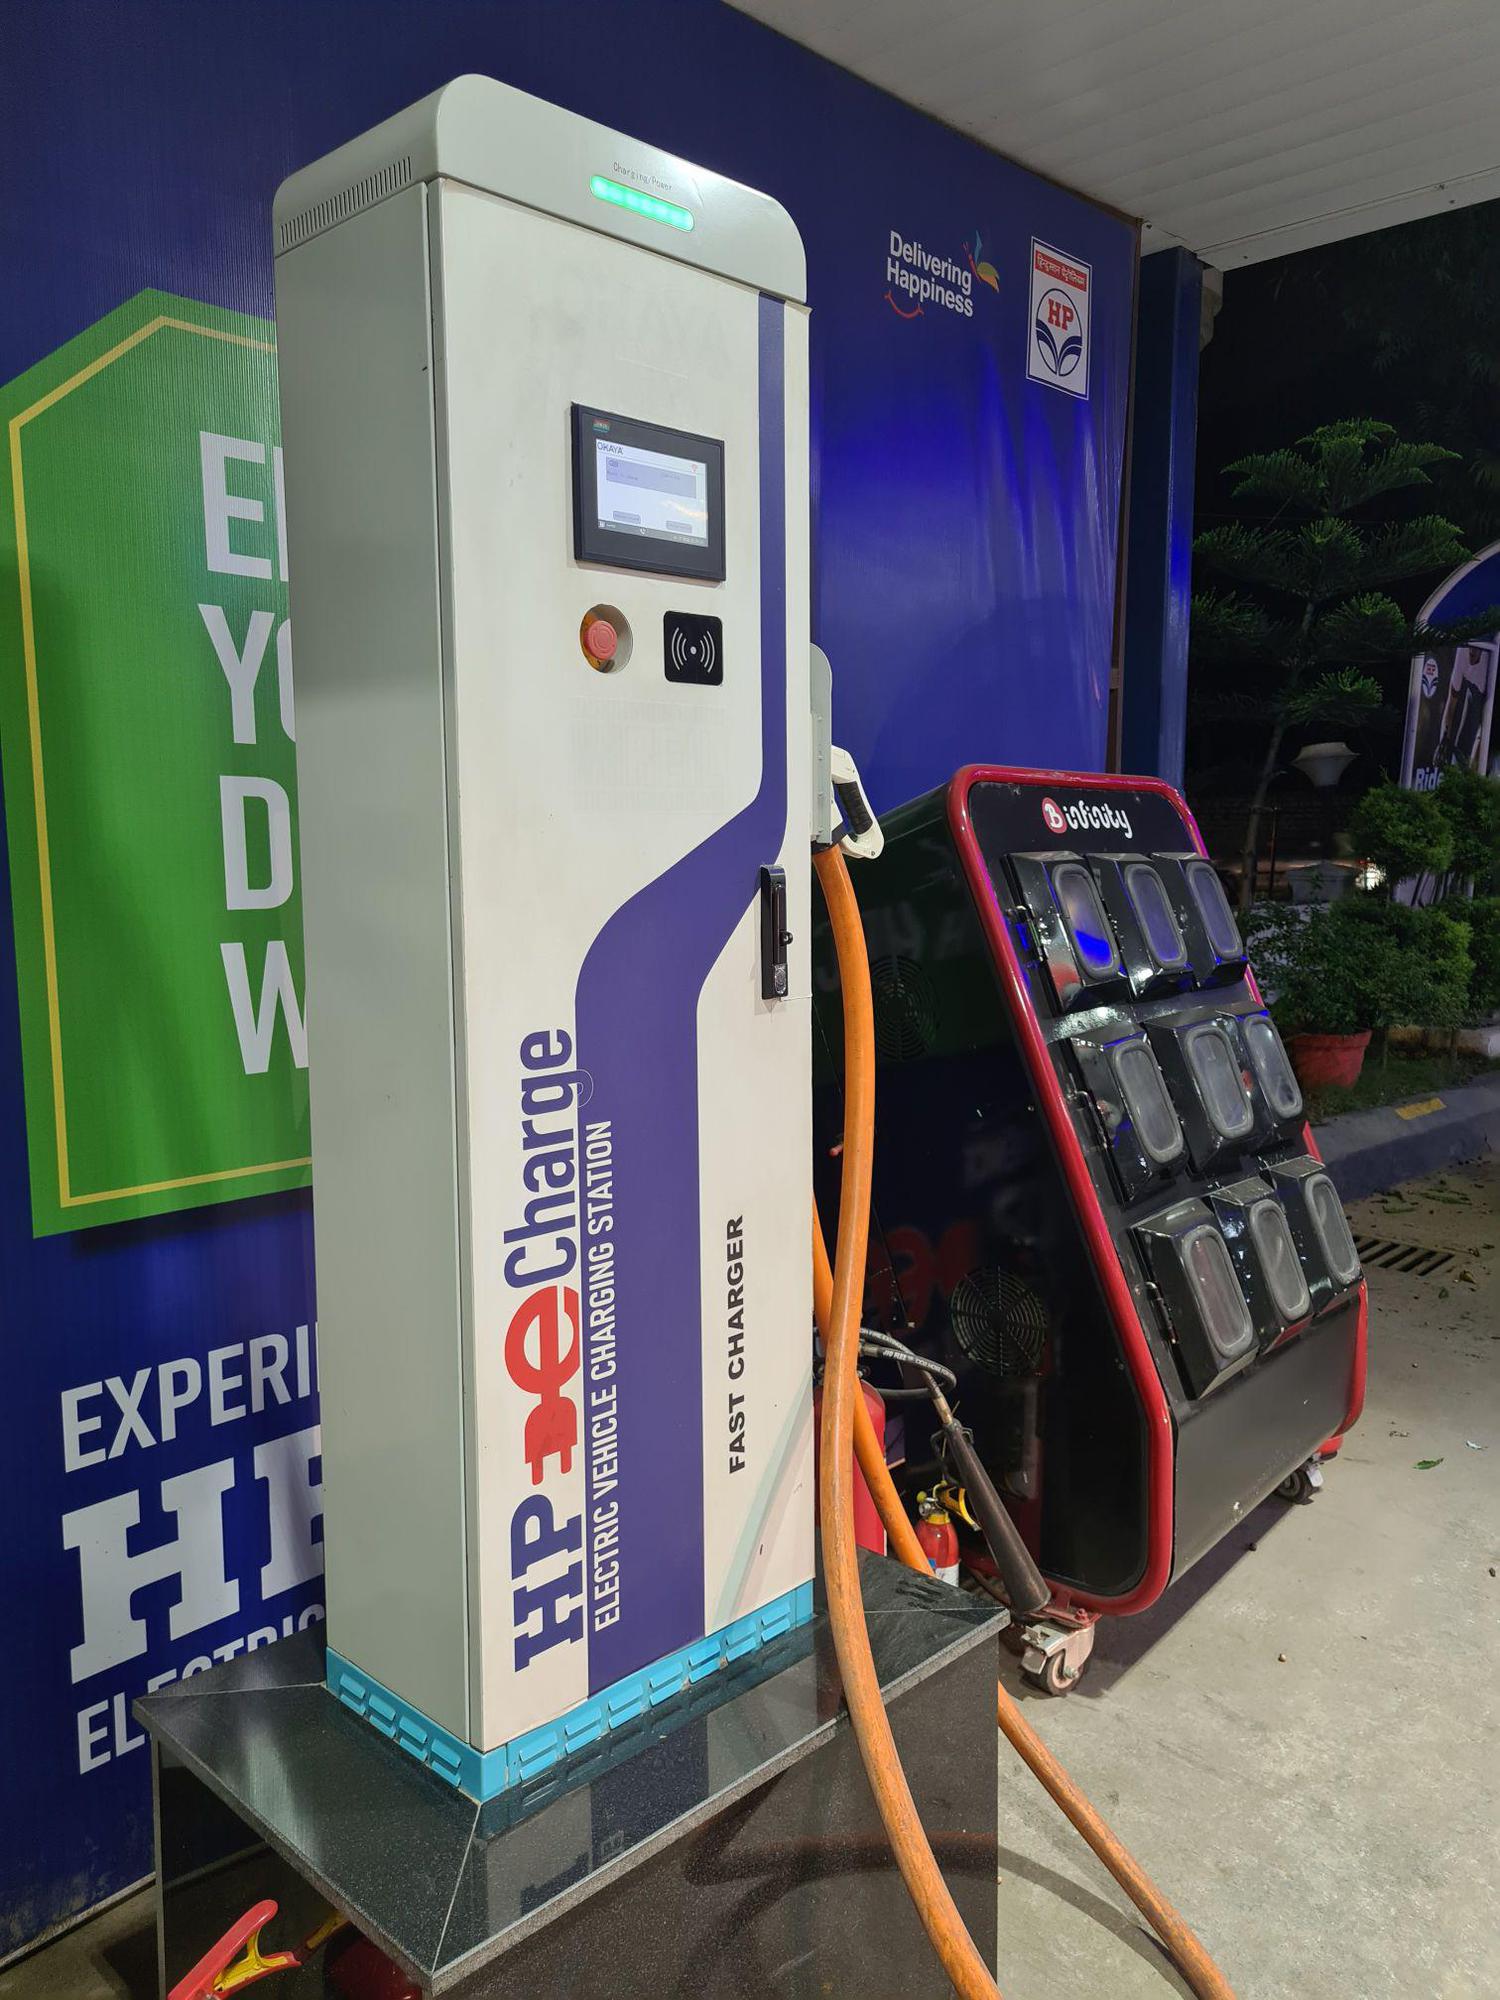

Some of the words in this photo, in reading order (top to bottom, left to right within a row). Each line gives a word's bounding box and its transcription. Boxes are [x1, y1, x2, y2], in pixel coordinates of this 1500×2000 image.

[886, 257, 973, 317] Happiness
[890, 230, 972, 295] Delivering
[1047, 298, 1074, 331] HP
[596, 441, 624, 455] OKAYA
[199, 431, 289, 582] E
[198, 603, 297, 745] Y
[586, 1120, 613, 1236] STATION
[588, 1242, 616, 1382] CHARGING
[726, 1215, 744, 1380] CHARGER
[61, 1321, 320, 1473] EXPERI
[591, 1384, 618, 1494] VEHICLE
[729, 1393, 745, 1474] FAST
[594, 1501, 620, 1632] ELECTRIC
